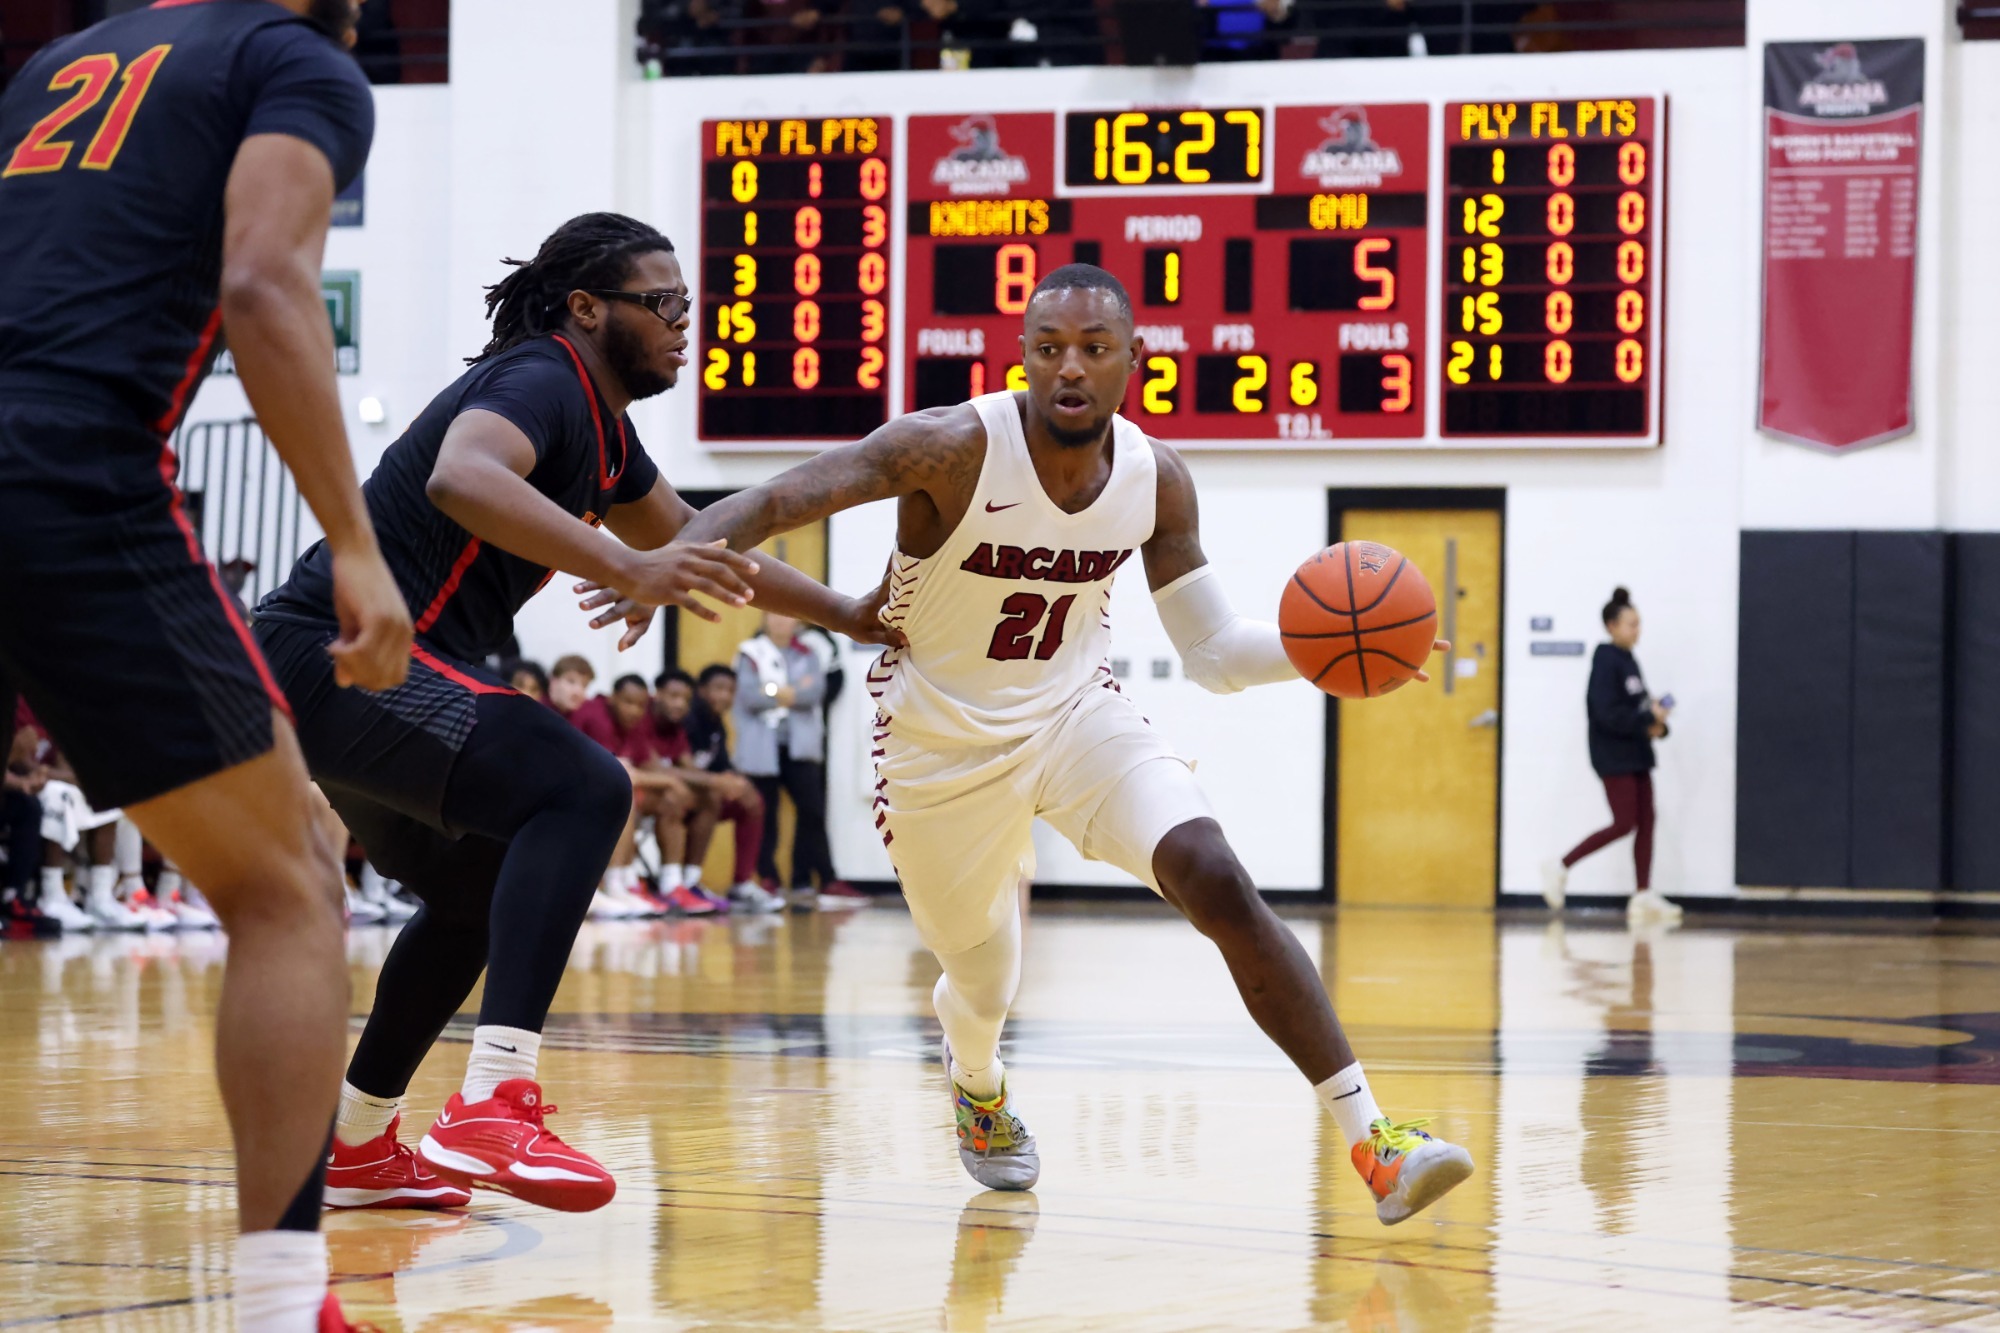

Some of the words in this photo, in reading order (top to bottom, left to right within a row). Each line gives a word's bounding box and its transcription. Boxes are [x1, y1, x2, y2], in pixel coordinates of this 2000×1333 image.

[2, 44, 173, 178] 21
[1460, 103, 1517, 140] PLY
[1530, 102, 1569, 139] FL
[1576, 100, 1636, 138] PTS
[715, 121, 768, 157] PLY
[779, 119, 817, 155] FL
[821, 118, 878, 154] PTS
[1094, 110, 1261, 184] 16:27
[732, 160, 758, 203] 0
[808, 162, 822, 198] 1
[859, 157, 887, 201] 0
[932, 157, 1029, 184] ARCADIA
[1301, 150, 1402, 177] ARCADIA
[1492, 148, 1505, 184] 1
[1547, 142, 1575, 187] 0
[1618, 141, 1646, 186] 0
[744, 211, 757, 246] 1
[795, 206, 822, 249] 0
[862, 204, 887, 248] 3
[929, 199, 1050, 237] KNIGHTS
[1125, 215, 1202, 242] PERIOD
[1309, 193, 1368, 230] GMU
[1463, 193, 1504, 238] 12
[1547, 192, 1574, 237] 0
[1617, 190, 1645, 235] 0
[733, 254, 757, 297] 3
[794, 252, 821, 296] 0
[858, 251, 886, 296] 0
[995, 243, 1037, 316] 8
[1164, 252, 1179, 302] 1
[1354, 237, 1395, 312] 5
[1463, 242, 1504, 287] 13
[1546, 241, 1574, 286] 0
[1617, 239, 1645, 285] 0
[717, 300, 756, 344] 15
[793, 299, 820, 343] 0
[861, 298, 885, 343] 3
[1462, 291, 1503, 336] 15
[1545, 290, 1573, 335] 0
[1616, 289, 1644, 334] 0
[917, 328, 985, 355] FOULS
[1212, 323, 1255, 351] PTS
[1338, 322, 1410, 350] FOULS
[703, 347, 756, 390] 21
[792, 346, 820, 390] 0
[857, 345, 885, 389] 2
[970, 361, 985, 399] 1
[1232, 355, 1268, 413] 2
[1290, 362, 1318, 406] 6
[1381, 354, 1412, 413] 3
[1447, 340, 1502, 385] 21
[1544, 339, 1572, 384] 0
[1615, 338, 1643, 383] 0
[1142, 356, 1178, 414] 2
[986, 591, 1078, 661] 21
